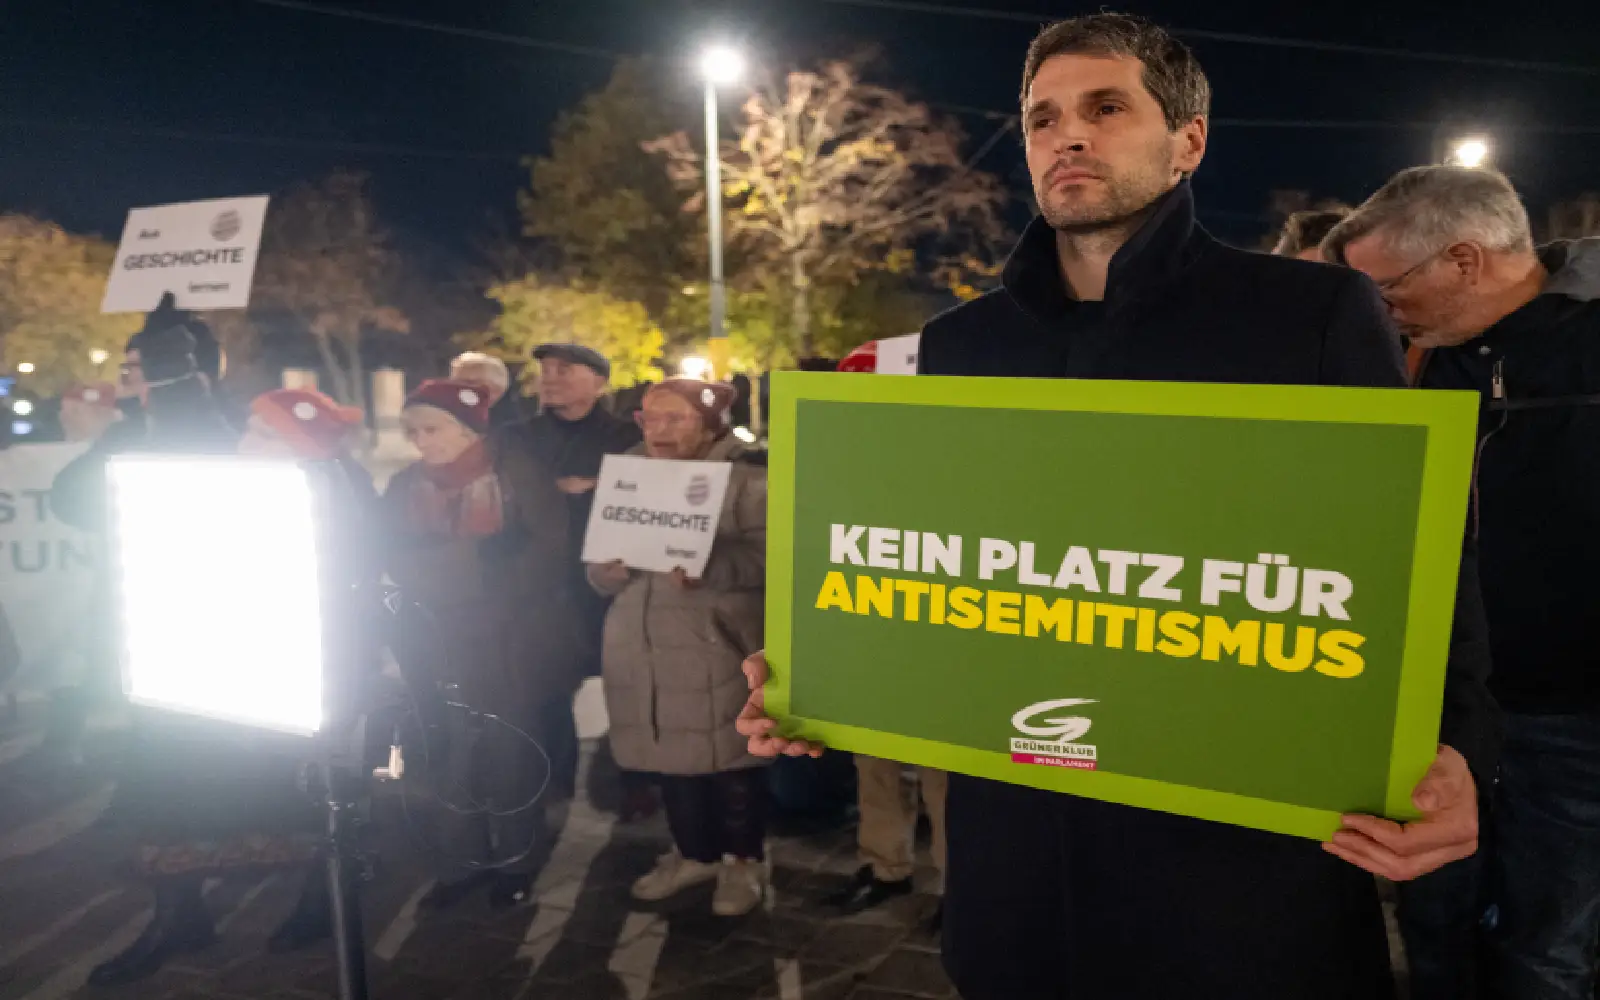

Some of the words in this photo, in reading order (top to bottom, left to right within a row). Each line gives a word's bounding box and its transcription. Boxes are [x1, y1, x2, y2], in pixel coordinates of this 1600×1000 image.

[123, 247, 245, 270] GESCHICHTE
[602, 505, 711, 532] GESCHICHTE
[829, 524, 963, 577] KEIN
[978, 537, 1184, 602] PLATZ
[1200, 553, 1354, 621] FÜR
[816, 571, 1367, 679] ANTISEMITISMUS
[1046, 757, 1095, 768] PARLAMENT
